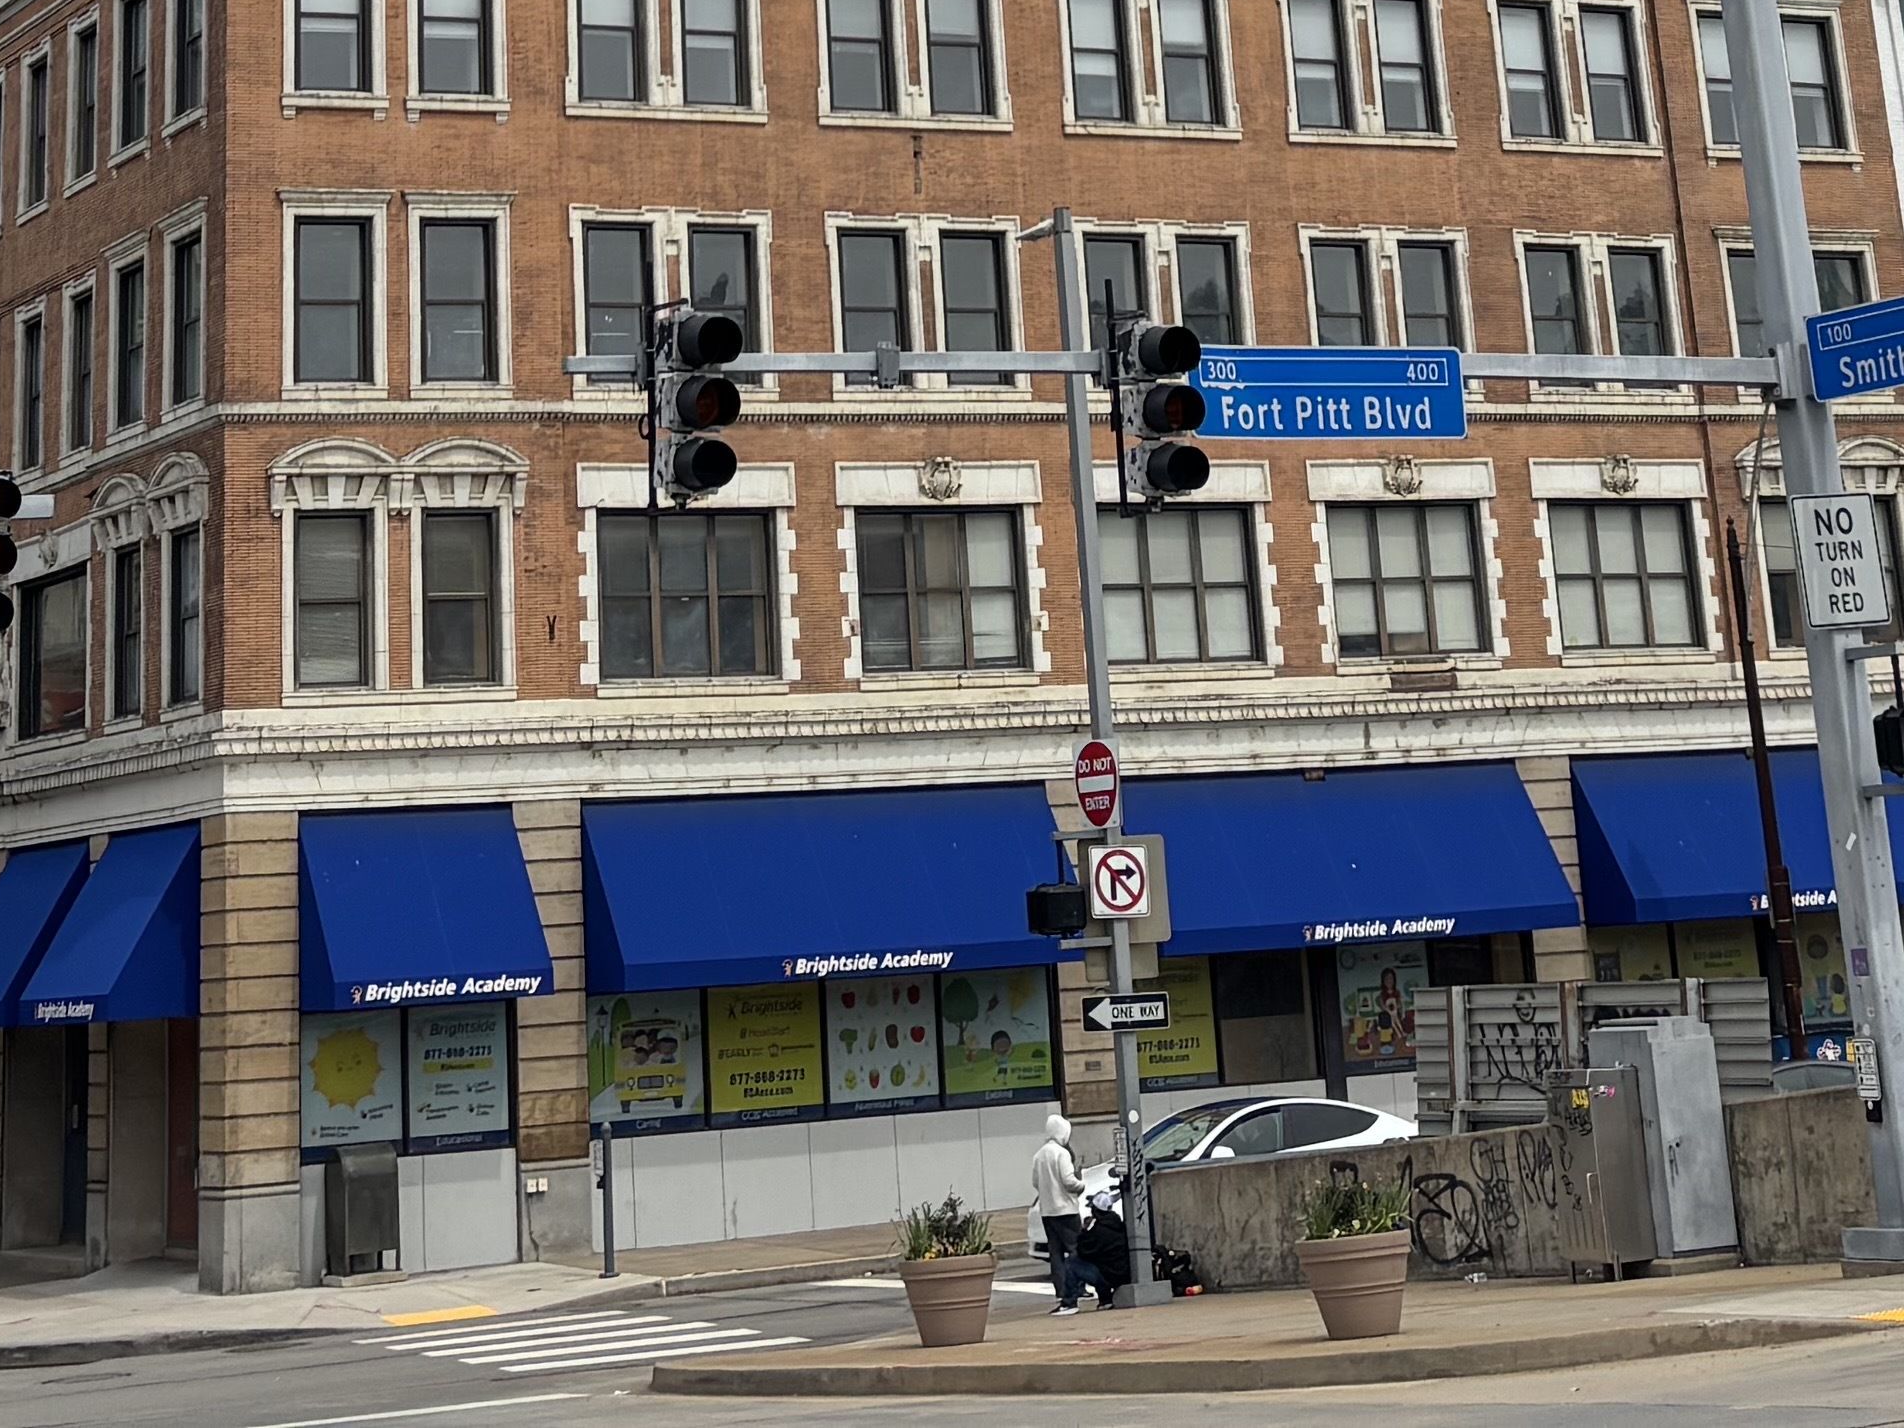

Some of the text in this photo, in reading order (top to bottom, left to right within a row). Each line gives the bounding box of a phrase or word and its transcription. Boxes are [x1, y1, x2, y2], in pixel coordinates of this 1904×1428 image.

[1826, 323, 1852, 343] 100
[1207, 361, 1438, 381] 300 400
[1221, 396, 1431, 430] Fort Pitt Blvd
[1814, 507, 1853, 536] NO
[1815, 540, 1863, 562] TURN
[1831, 567, 1856, 587] ON
[1829, 592, 1864, 614] RED
[1078, 756, 1111, 773] DO NOT
[1085, 794, 1110, 811] ENTER
[1760, 890, 1825, 909] Btside
[1314, 916, 1455, 942] Brightside Academy
[795, 949, 954, 977] Brightside Academy
[365, 974, 542, 1004] Brightside Academy
[1112, 1001, 1160, 1019] ONE WAY
[429, 1020, 496, 1038] Brightside
